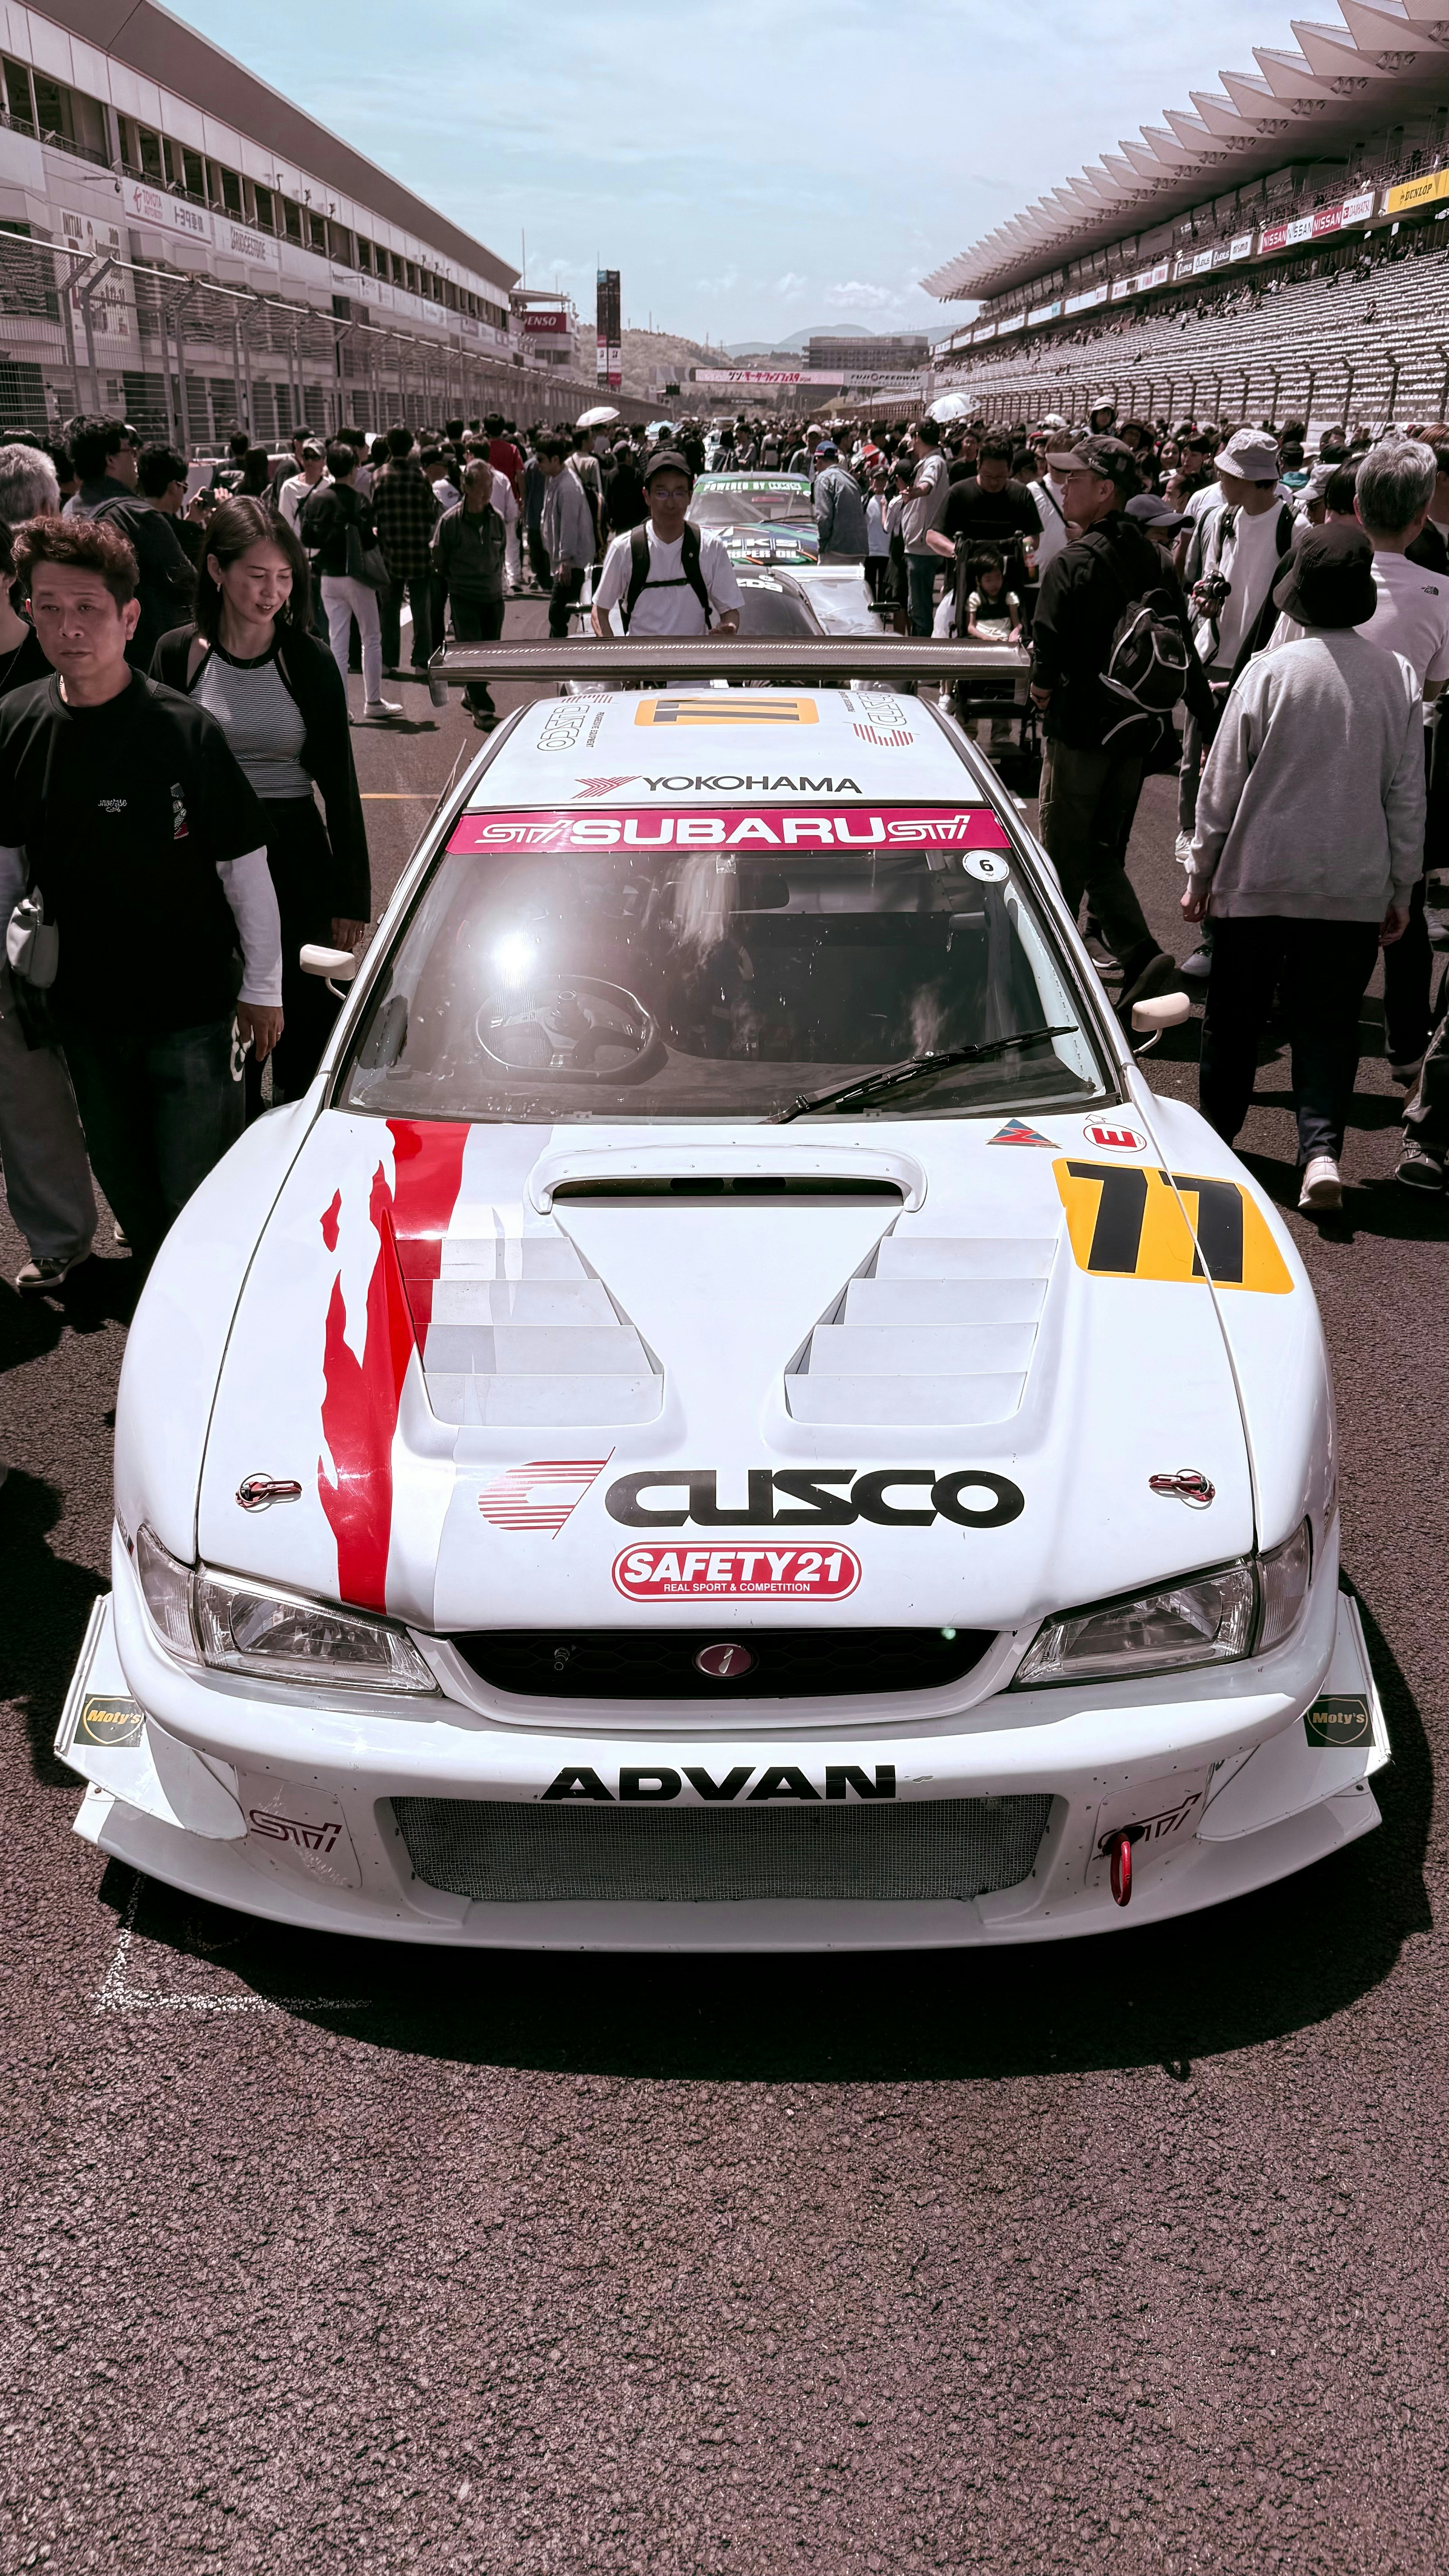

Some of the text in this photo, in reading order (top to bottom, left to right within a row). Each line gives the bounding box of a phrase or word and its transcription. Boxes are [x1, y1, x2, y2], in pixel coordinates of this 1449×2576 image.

[143, 189, 163, 208] TOYOTA
[1404, 183, 1433, 201] DUNLOP
[1348, 200, 1371, 218] DAIHATSU
[1287, 221, 1312, 239] NISSAN
[1313, 211, 1342, 232] NISSAN
[231, 226, 266, 260] BRIDGESTONE
[1263, 229, 1287, 247] NISSAN
[1233, 242, 1248, 254] nismo
[704, 481, 802, 491] POWERED BY HKS
[722, 538, 798, 548] HKS
[775, 550, 800, 559] OIL
[856, 692, 907, 726] CUSCO
[537, 704, 590, 751] CUSCO
[643, 776, 863, 794] YOKOHAMA
[569, 817, 887, 846] SUBARU
[979, 860, 994, 872] 6
[1091, 1127, 1138, 1148] E
[605, 1469, 1025, 1529] CUSCO
[664, 1583, 811, 1592] REAL SPORT & COMPETITION
[87, 1709, 142, 1725] Moty's
[1312, 1712, 1365, 1725] Moty's
[540, 1765, 897, 1801] ADVAN
